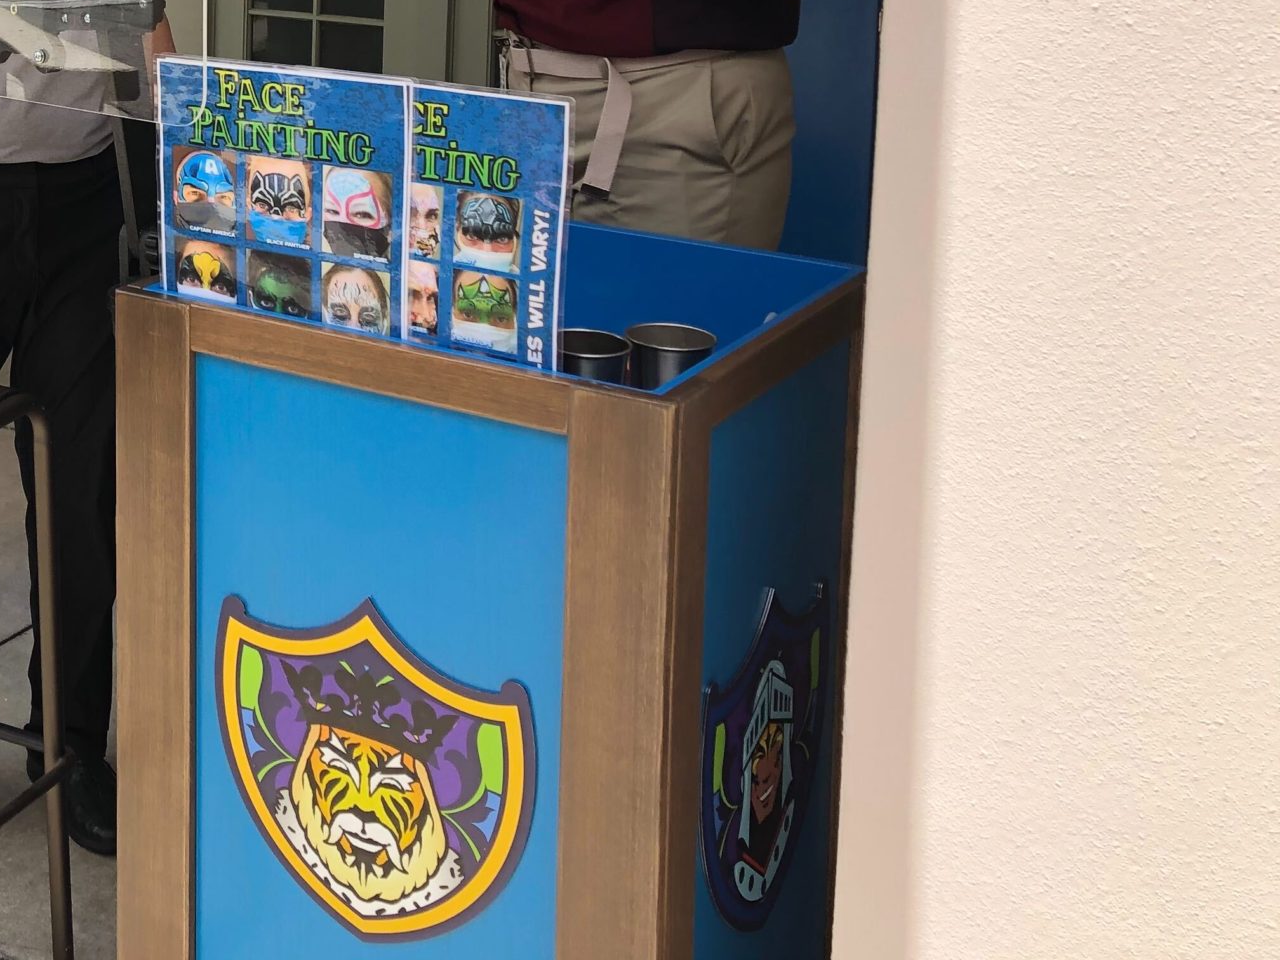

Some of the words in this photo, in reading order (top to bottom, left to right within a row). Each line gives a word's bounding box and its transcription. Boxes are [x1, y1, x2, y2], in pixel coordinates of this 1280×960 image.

[214, 68, 306, 116] FACE
[188, 106, 374, 165] PAINTING
[530, 208, 551, 273] VARY!
[527, 279, 546, 329] WILL
[527, 335, 543, 369] ES
